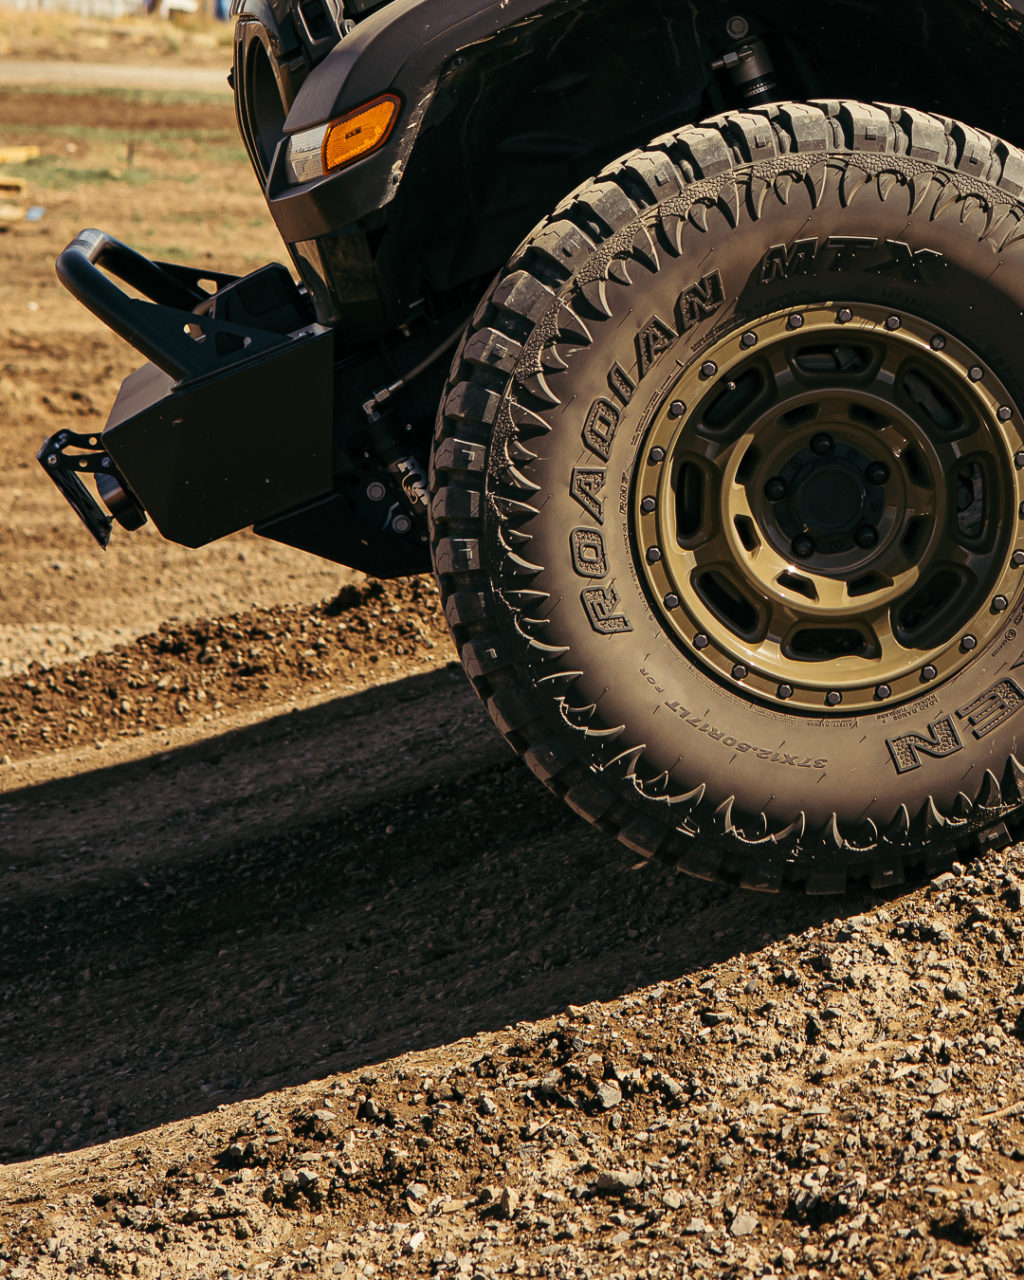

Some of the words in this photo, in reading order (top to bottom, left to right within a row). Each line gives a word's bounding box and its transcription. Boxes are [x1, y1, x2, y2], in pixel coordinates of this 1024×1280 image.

[569, 267, 726, 635] ROADIAN
[759, 235, 943, 285] MTX
[663, 699, 829, 770] 37X12.50R17LT
